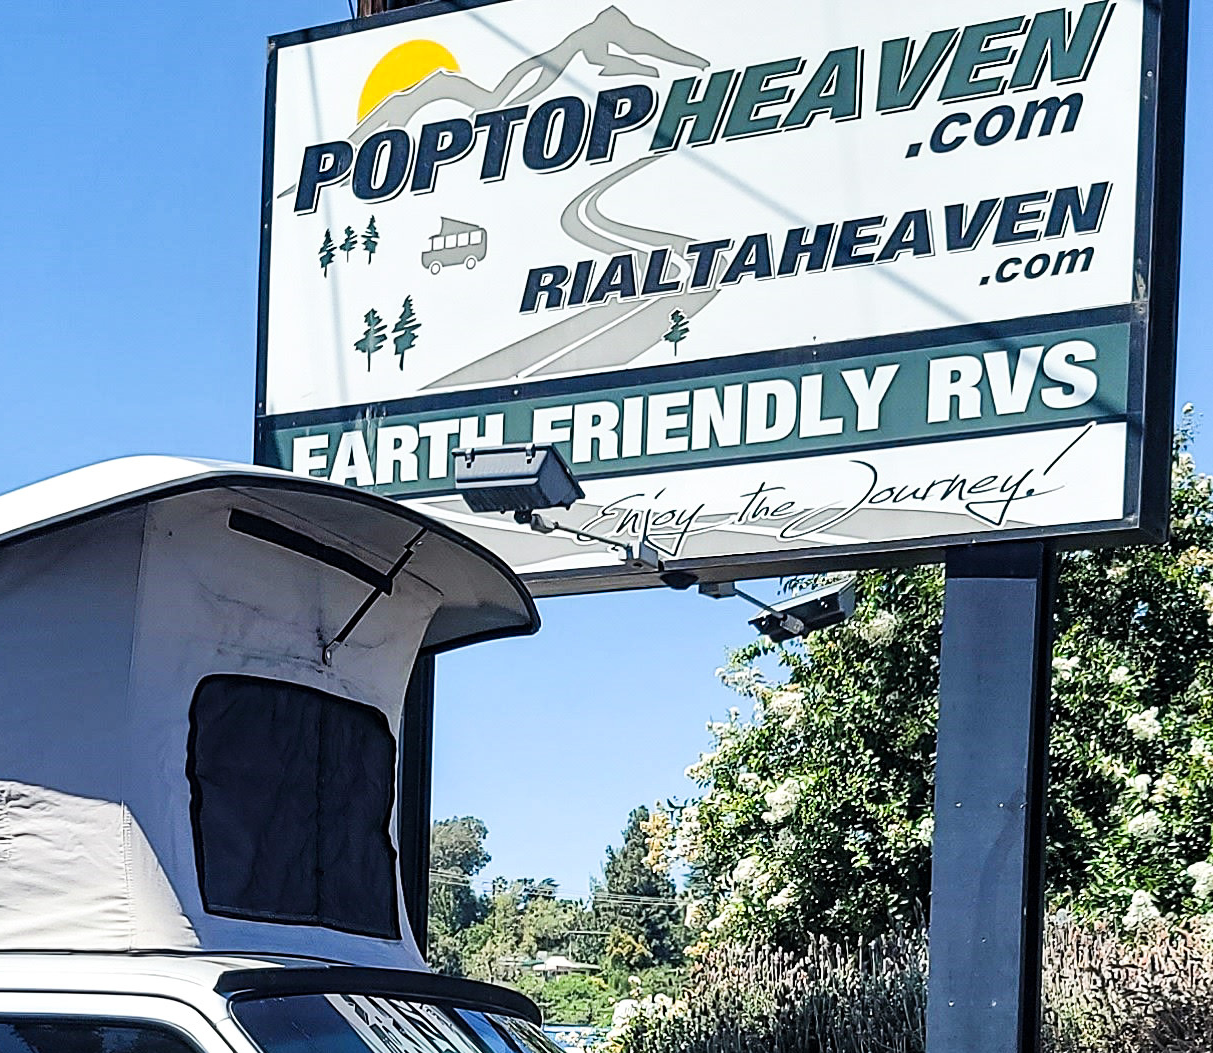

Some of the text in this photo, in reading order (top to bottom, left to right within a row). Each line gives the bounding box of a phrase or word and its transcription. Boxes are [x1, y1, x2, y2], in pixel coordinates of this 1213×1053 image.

[905, 92, 1084, 158] .com
[519, 181, 1113, 314] RIALTAHEAVEN
[979, 245, 1095, 286] .com
[927, 340, 1098, 424] RVS
[577, 424, 1093, 557] Enjoy the Journey!
